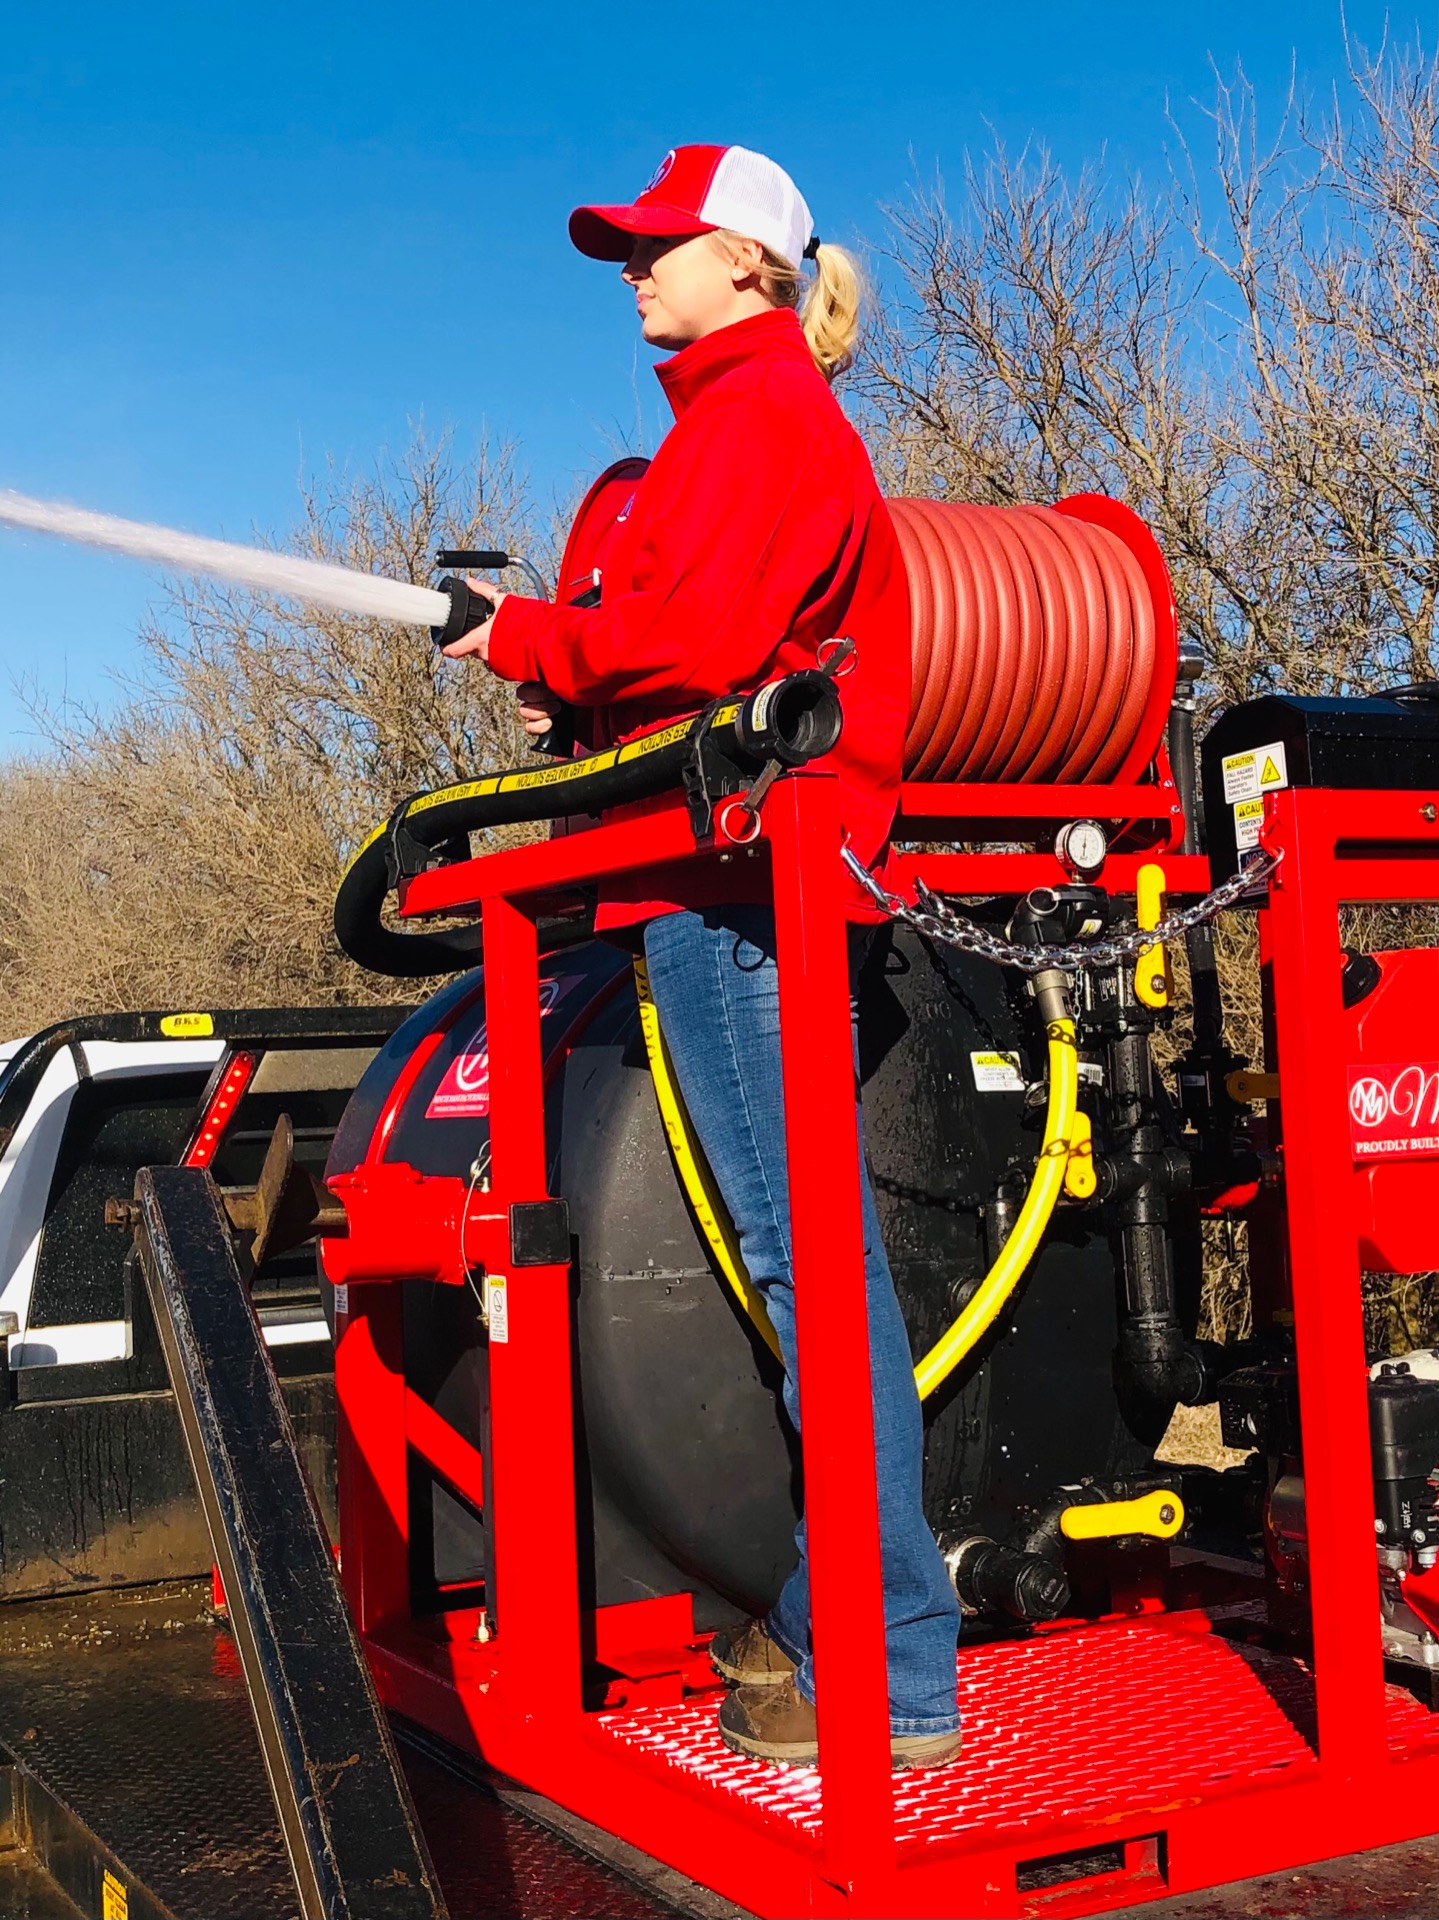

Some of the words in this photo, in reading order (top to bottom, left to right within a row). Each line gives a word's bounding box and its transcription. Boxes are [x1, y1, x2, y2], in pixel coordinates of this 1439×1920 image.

[1231, 755, 1254, 768] CAUTION
[516, 771, 545, 788] SUCTION
[545, 766, 570, 783] WATER
[1246, 802, 1264, 816] CAUT
[1356, 1140, 1409, 1154] PROUDLY
[947, 1495, 973, 1518] 25
